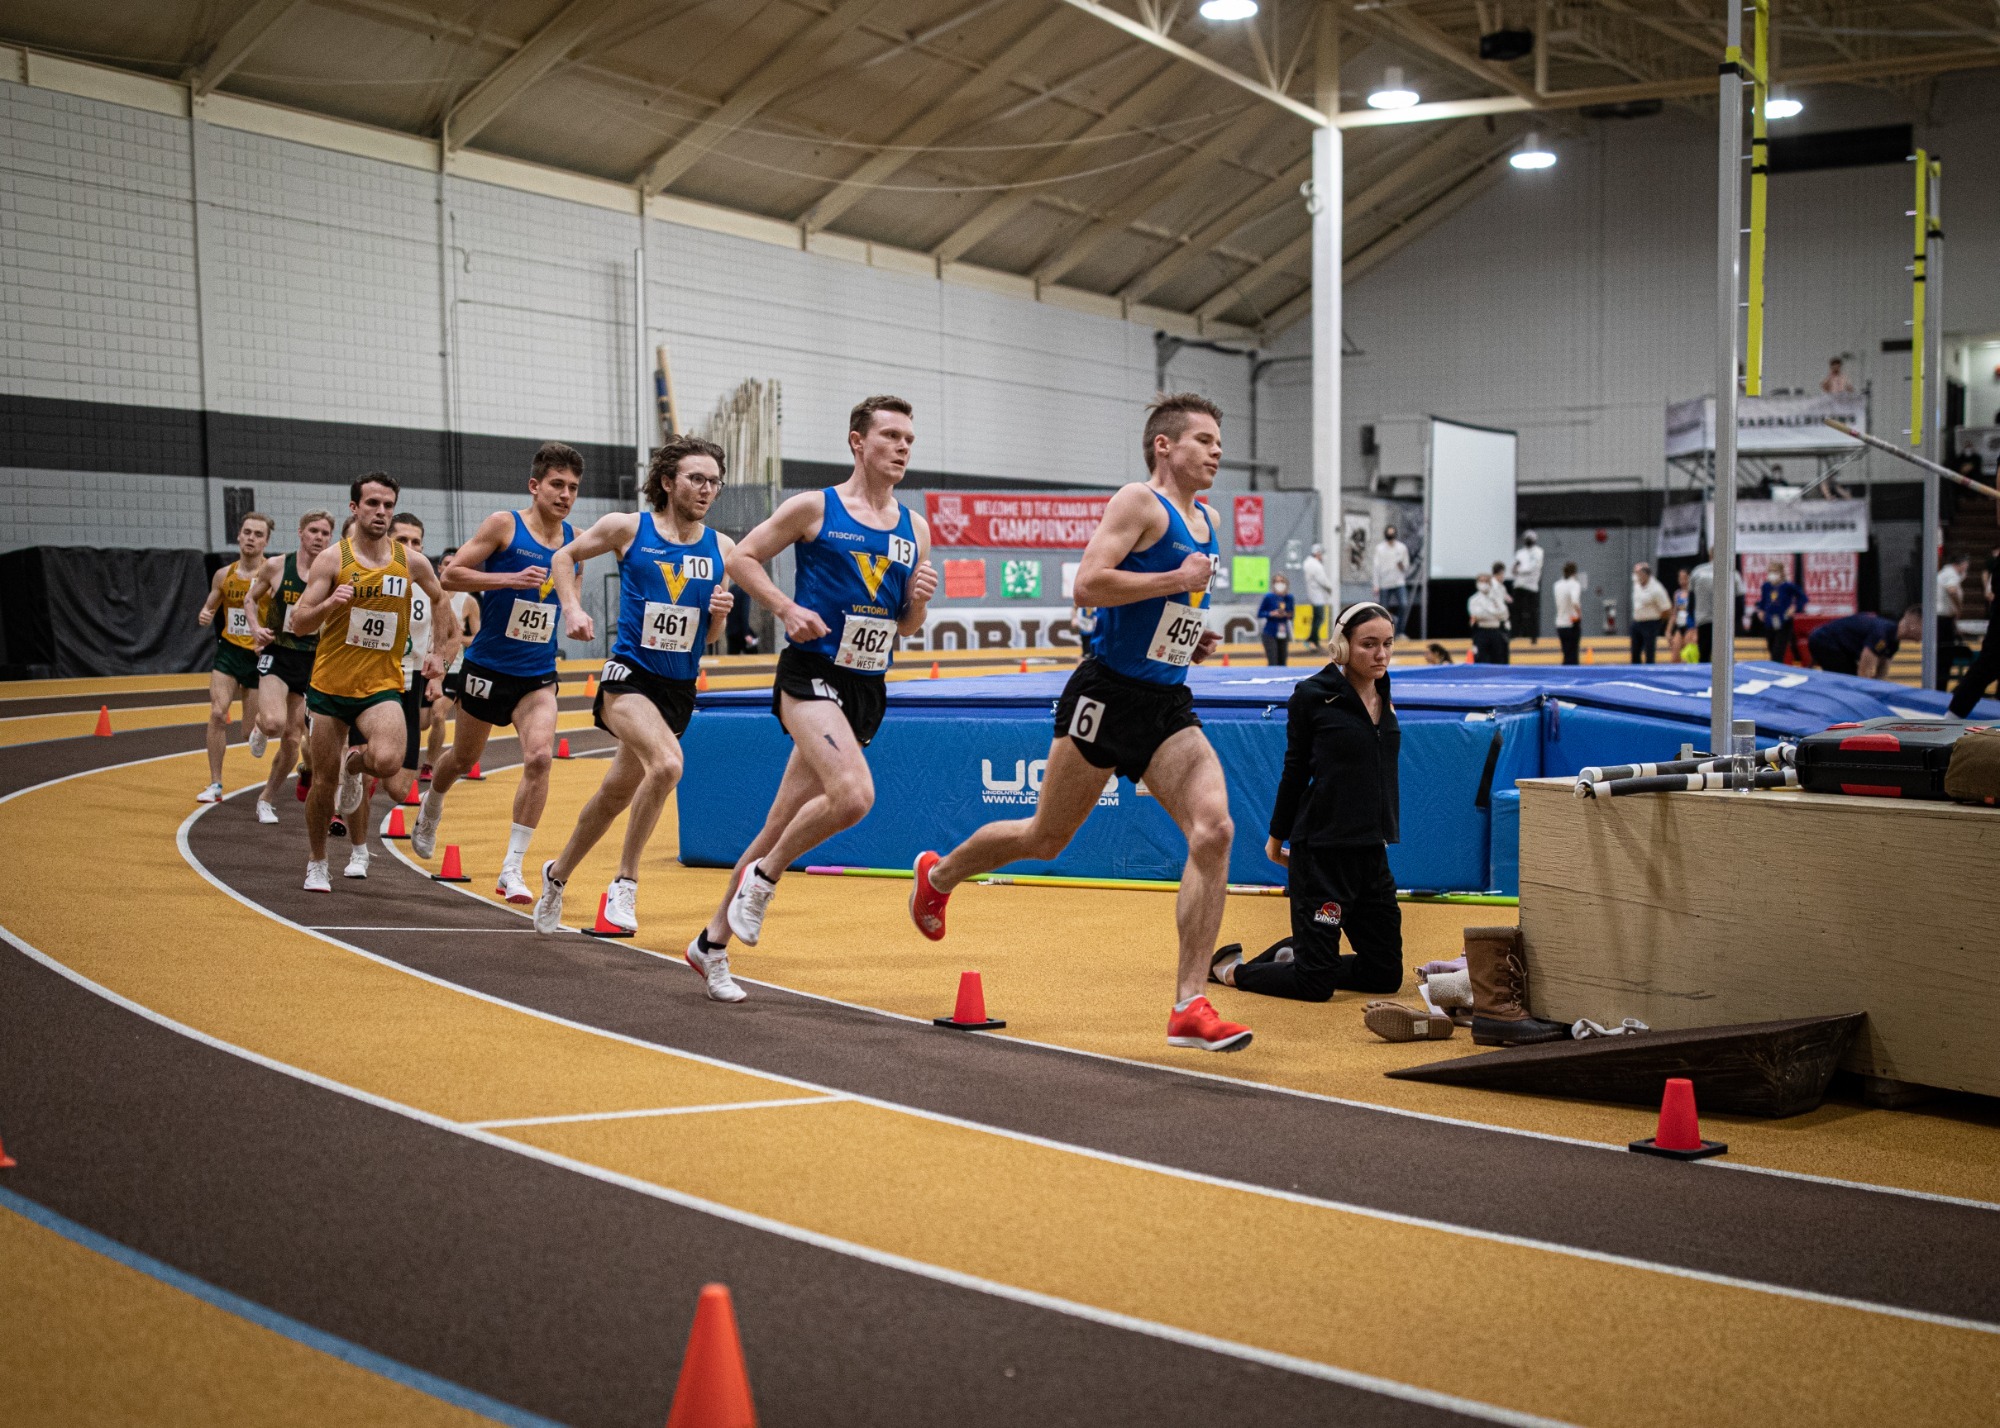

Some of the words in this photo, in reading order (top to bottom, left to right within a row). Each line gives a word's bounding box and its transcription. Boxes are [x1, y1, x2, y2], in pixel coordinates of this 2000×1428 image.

[974, 500, 1019, 516] WELCOME
[1021, 501, 1033, 516] TO
[1035, 501, 1051, 516] THE
[1053, 502, 1089, 517] CANADA
[1091, 502, 1106, 517] WE
[828, 530, 865, 543] macron
[989, 517, 1101, 542] CHAMPIONSHIP
[516, 548, 544, 560] macron
[640, 546, 667, 555] macron
[894, 538, 912, 564] 13
[688, 557, 709, 579] 10
[849, 551, 894, 602] V
[387, 577, 403, 596] 11
[413, 599, 424, 621] 8
[518, 609, 548, 630] 451
[852, 604, 889, 616] VICTORIA
[233, 613, 246, 627] 39
[362, 617, 385, 637] 49
[653, 612, 688, 637] 461
[522, 633, 539, 641] WEST
[851, 627, 888, 653] 462
[1166, 616, 1202, 647] 456
[362, 640, 379, 648] WEST
[660, 641, 677, 650] WEST
[856, 659, 876, 669] WEST
[1167, 653, 1186, 665] WEST
[608, 663, 626, 681] 10
[469, 678, 486, 697] 12
[1076, 702, 1097, 737] 6
